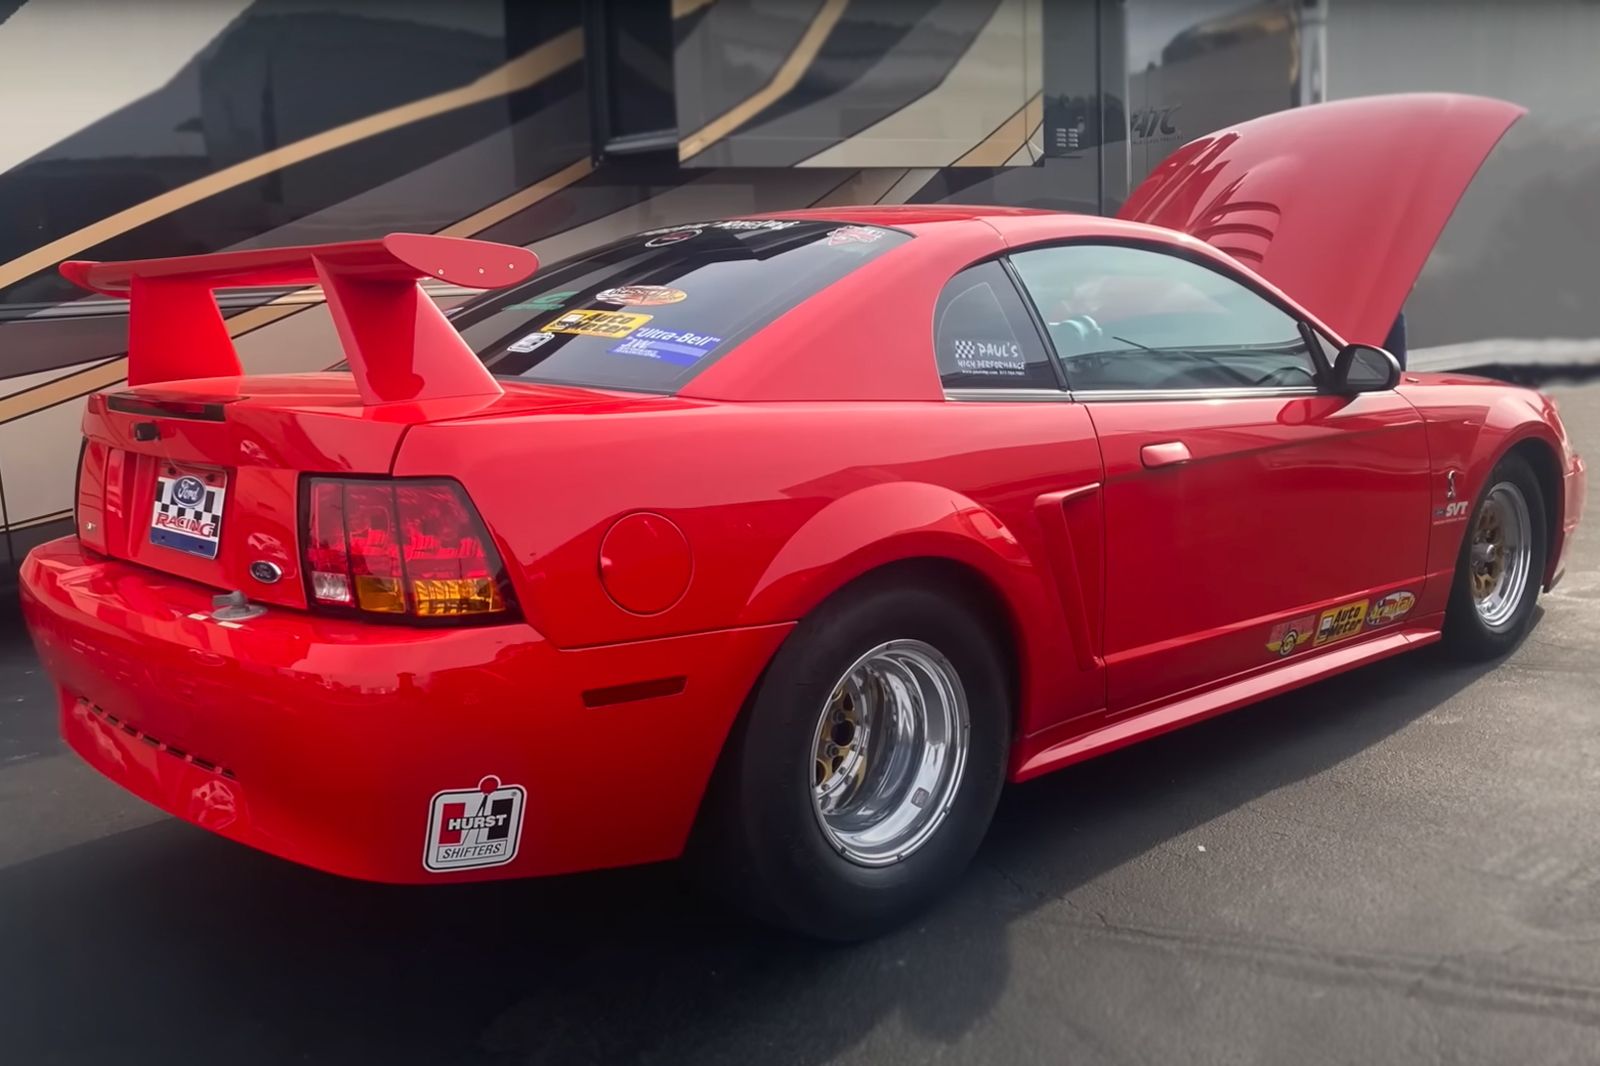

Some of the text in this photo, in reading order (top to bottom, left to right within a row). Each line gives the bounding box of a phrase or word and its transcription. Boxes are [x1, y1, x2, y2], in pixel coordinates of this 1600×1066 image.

[976, 341, 1018, 357] PAUL'S
[178, 479, 200, 501] Ford
[1446, 501, 1469, 517] SVT
[155, 512, 216, 538] RACING
[1334, 604, 1362, 623] Auto
[448, 814, 507, 830] HURST
[442, 843, 501, 860] SHIFTERS
